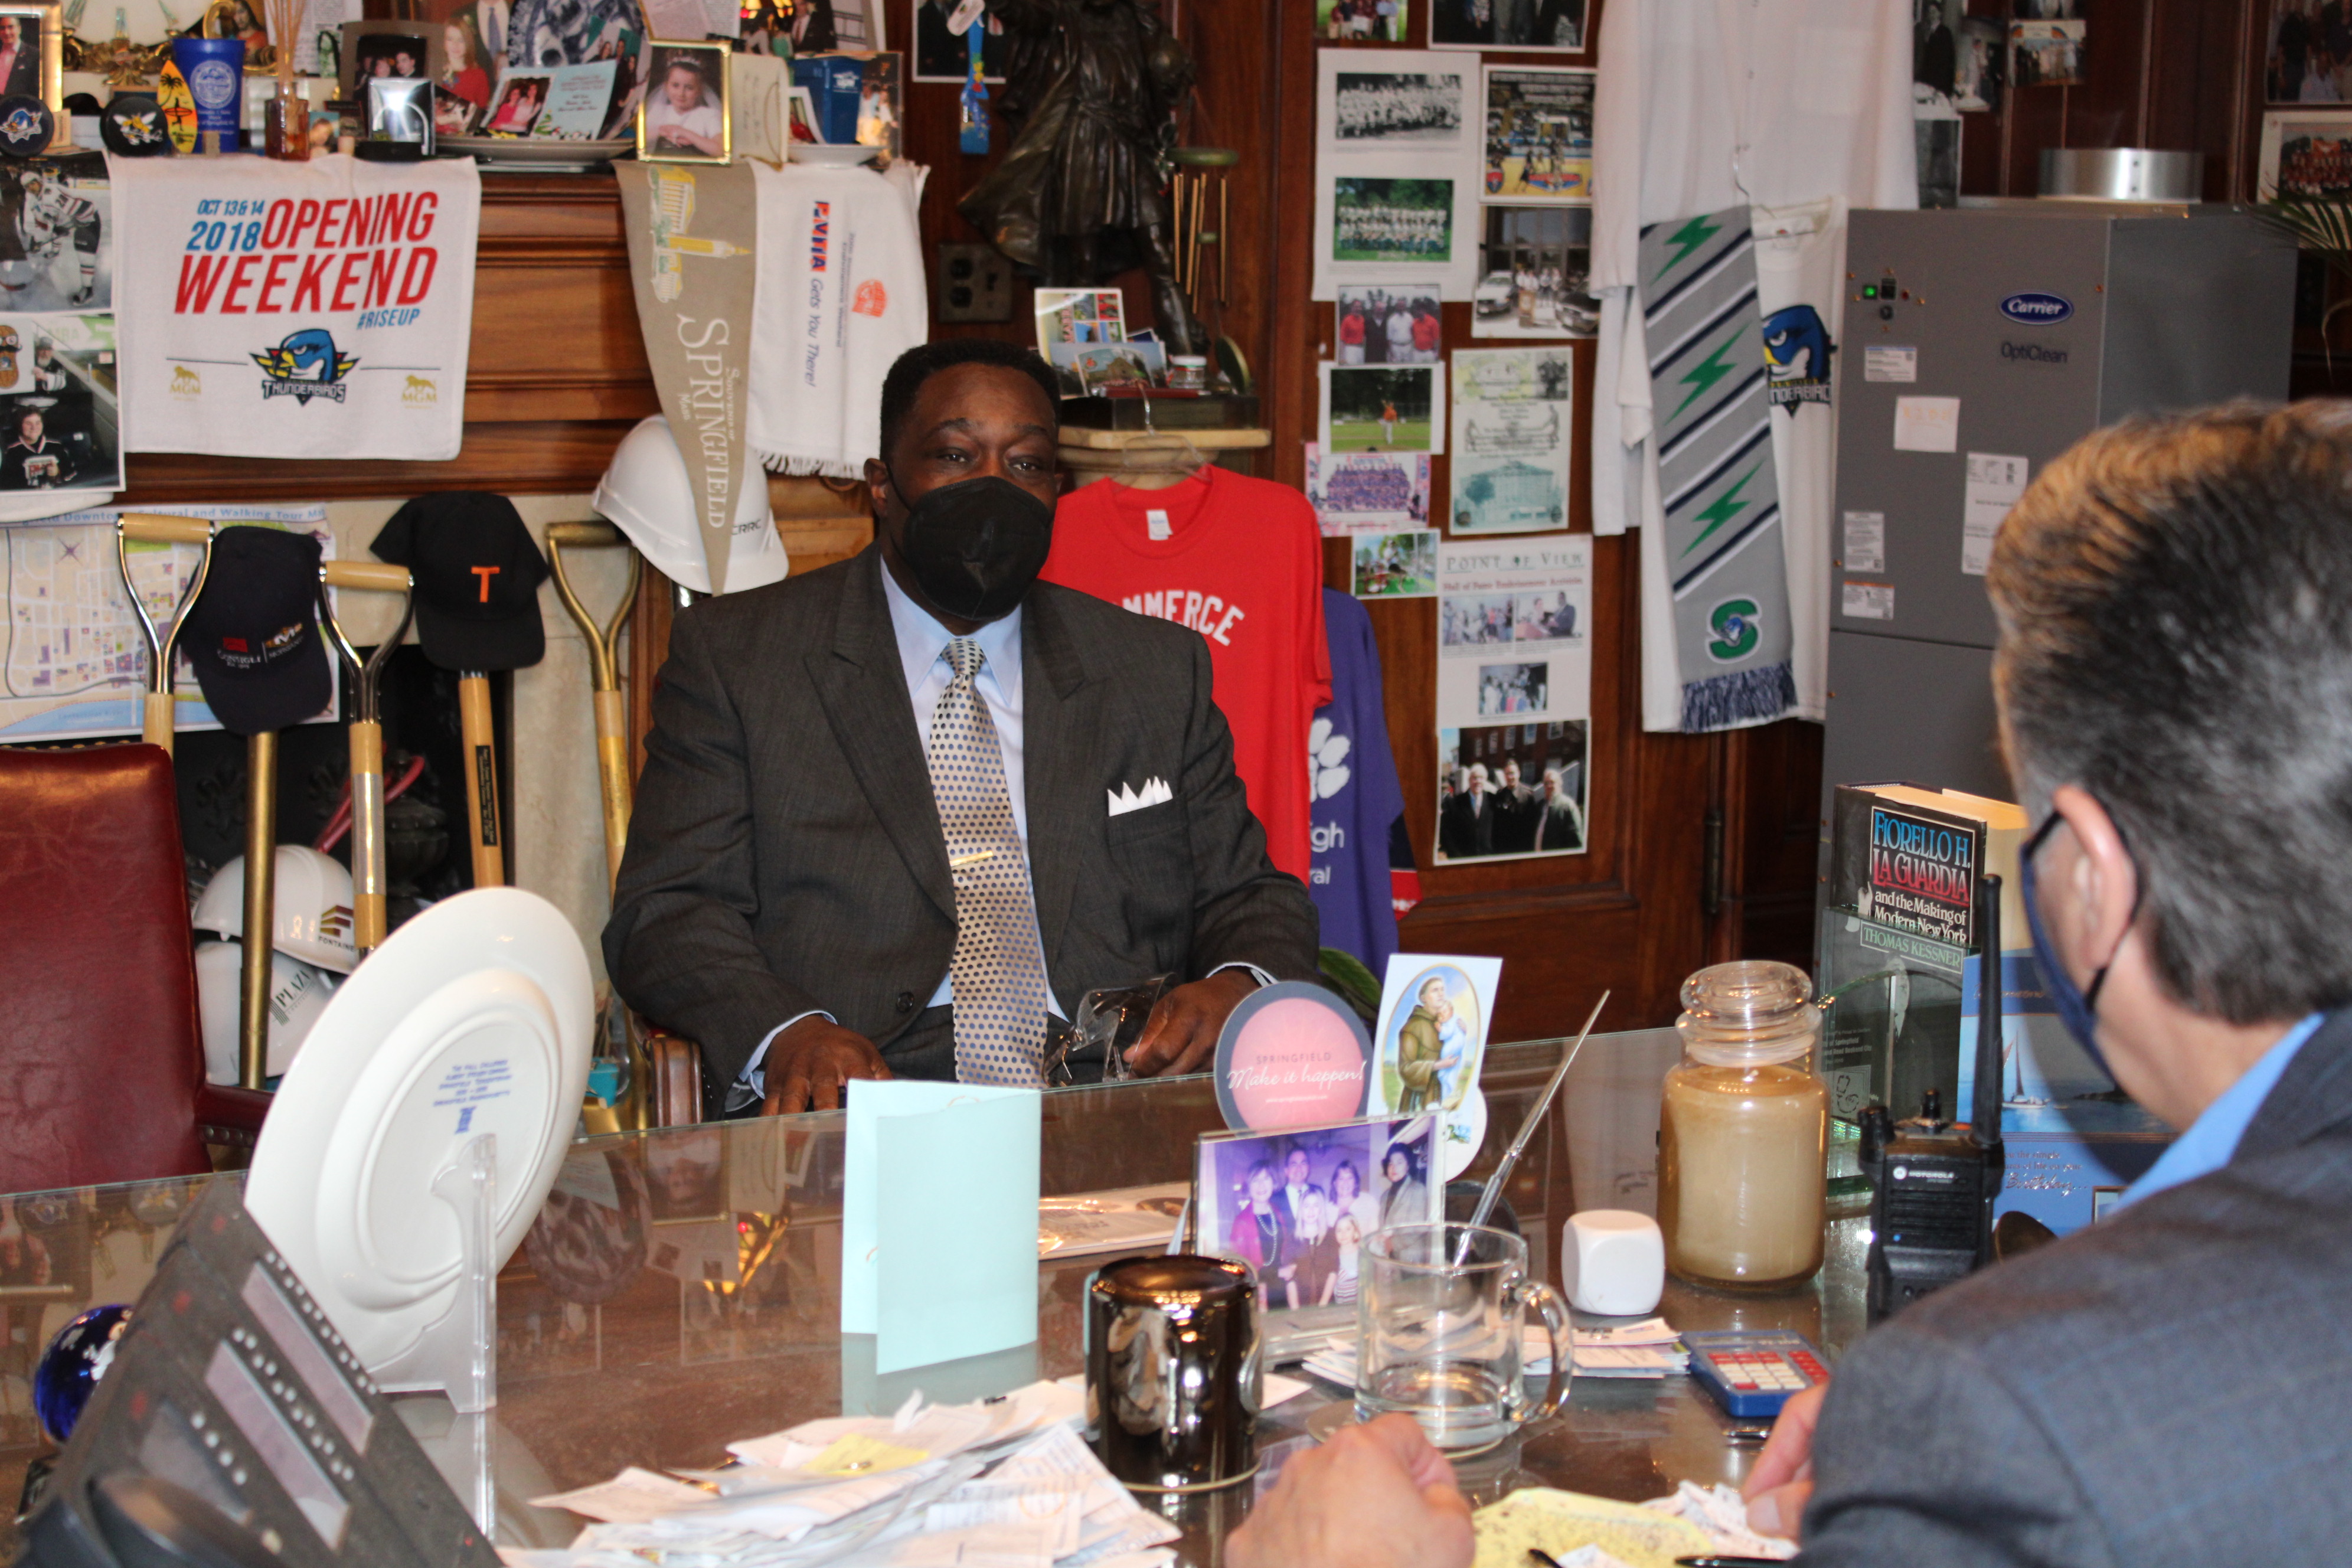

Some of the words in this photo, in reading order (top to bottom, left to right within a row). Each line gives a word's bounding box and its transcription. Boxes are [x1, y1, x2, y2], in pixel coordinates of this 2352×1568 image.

[197, 200, 223, 215] OCT
[251, 200, 265, 215] 14
[261, 192, 438, 250] OPENING
[186, 221, 262, 251] 2018
[174, 247, 438, 314] WEEKEND
[810, 278, 824, 309] Gets
[357, 308, 420, 330] #RISEUP
[2008, 298, 2063, 315] Carrier
[808, 315, 821, 339] You
[804, 344, 820, 387] There!
[2001, 342, 2067, 362] OptiClean
[169, 384, 202, 396] MGM
[263, 381, 345, 403] THUNDERBIRDS
[401, 391, 437, 403] MGM
[676, 313, 730, 528] SPRINGFIELD
[193, 509, 215, 517] and
[220, 508, 270, 520] Walking
[275, 511, 302, 520] Tour
[1446, 555, 1501, 570] POINT
[1541, 552, 1582, 565] VIEW
[471, 566, 499, 602] T
[1113, 589, 1245, 646] MMERCE
[1309, 820, 1344, 853] gh
[1873, 812, 1952, 863] FIORELLO
[1954, 835, 1971, 868] H.
[1873, 848, 1892, 886] LA
[1894, 853, 1970, 902] GUARDIA
[1875, 891, 1895, 906] and
[1896, 894, 1913, 911] the
[1913, 897, 1954, 926] Making
[1954, 910, 1966, 926] of
[1874, 905, 1918, 929] Modern
[1917, 917, 1941, 936] New
[1941, 923, 1966, 943] York
[319, 936, 354, 952] FONTAINE
[1864, 927, 1909, 953] THOMAS
[1910, 941, 1961, 967] KESSNER
[1256, 1053, 1331, 1064] SPRINGFIELD
[1227, 1066, 1279, 1090] Make
[1284, 1072, 1298, 1083] it
[1301, 1060, 1367, 1090] happen!
[2033, 1151, 2060, 1159] simple
